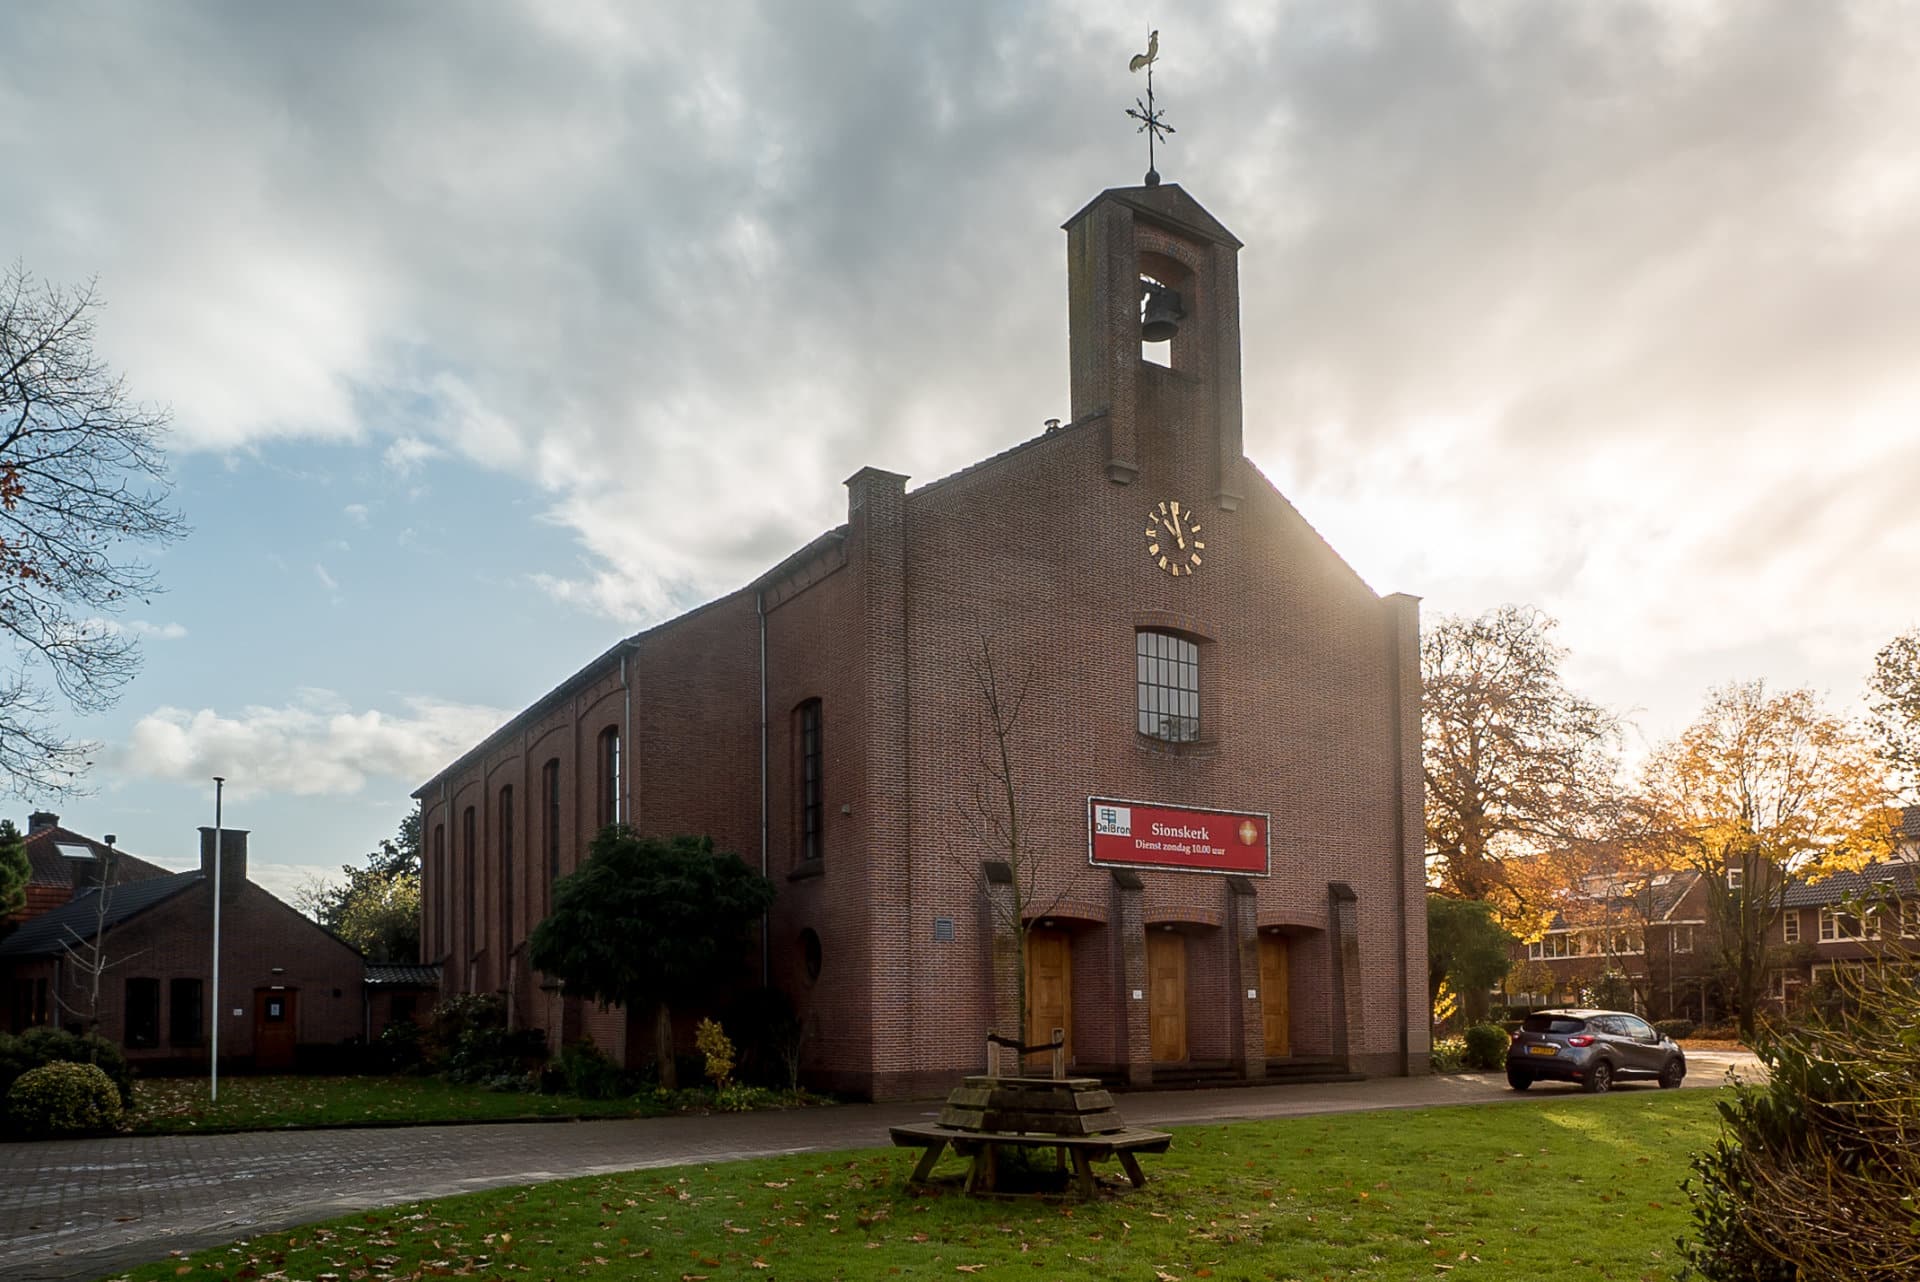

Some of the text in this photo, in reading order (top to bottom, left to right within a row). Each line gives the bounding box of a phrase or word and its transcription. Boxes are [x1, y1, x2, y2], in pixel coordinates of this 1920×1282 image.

[1151, 822, 1210, 840] Sionskerk
[1135, 839, 1161, 850] Dienst
[1163, 842, 1191, 855] zondag
[1192, 844, 1211, 854] 10.00
